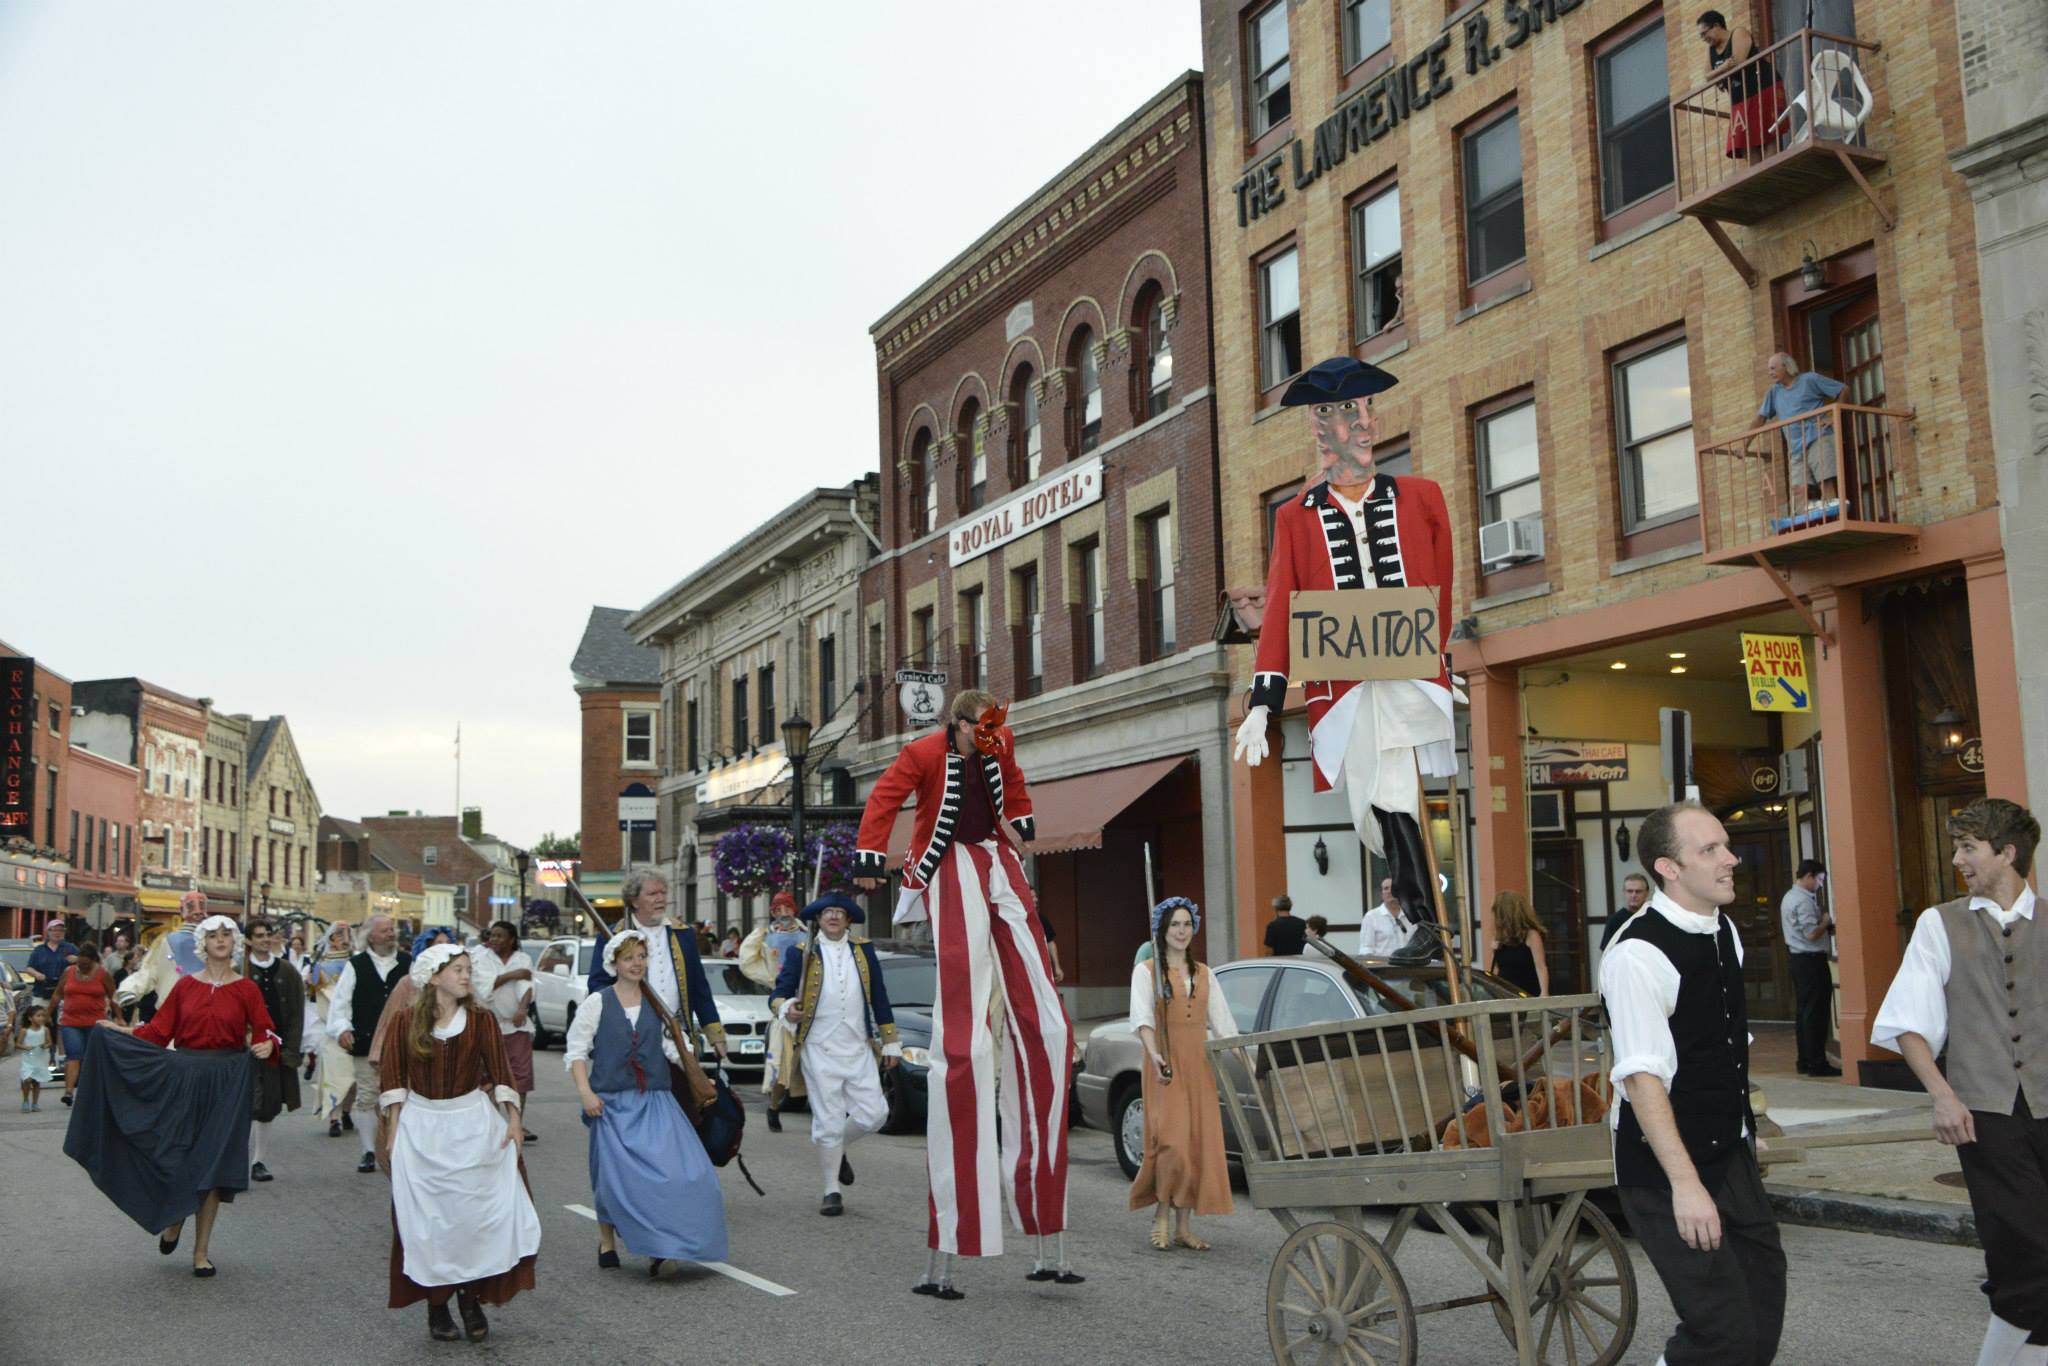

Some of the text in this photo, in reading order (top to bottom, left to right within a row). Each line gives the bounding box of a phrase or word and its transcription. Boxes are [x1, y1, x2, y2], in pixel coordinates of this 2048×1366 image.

[1232, 153, 1285, 227] THE
[1292, 32, 1453, 190] LAWRENCE
[1463, 10, 1502, 75] R.
[961, 474, 1084, 556] ROYAL HOTEL
[1292, 608, 1438, 659] TRAITOR
[1746, 640, 1801, 660] 24 HOUR
[1751, 659, 1803, 677] ATM
[6, 670, 24, 805] EXCHANGE
[1599, 746, 1624, 758] CAFE
[1588, 768, 1626, 781] LIGHT
[0, 811, 29, 826] CAFE
